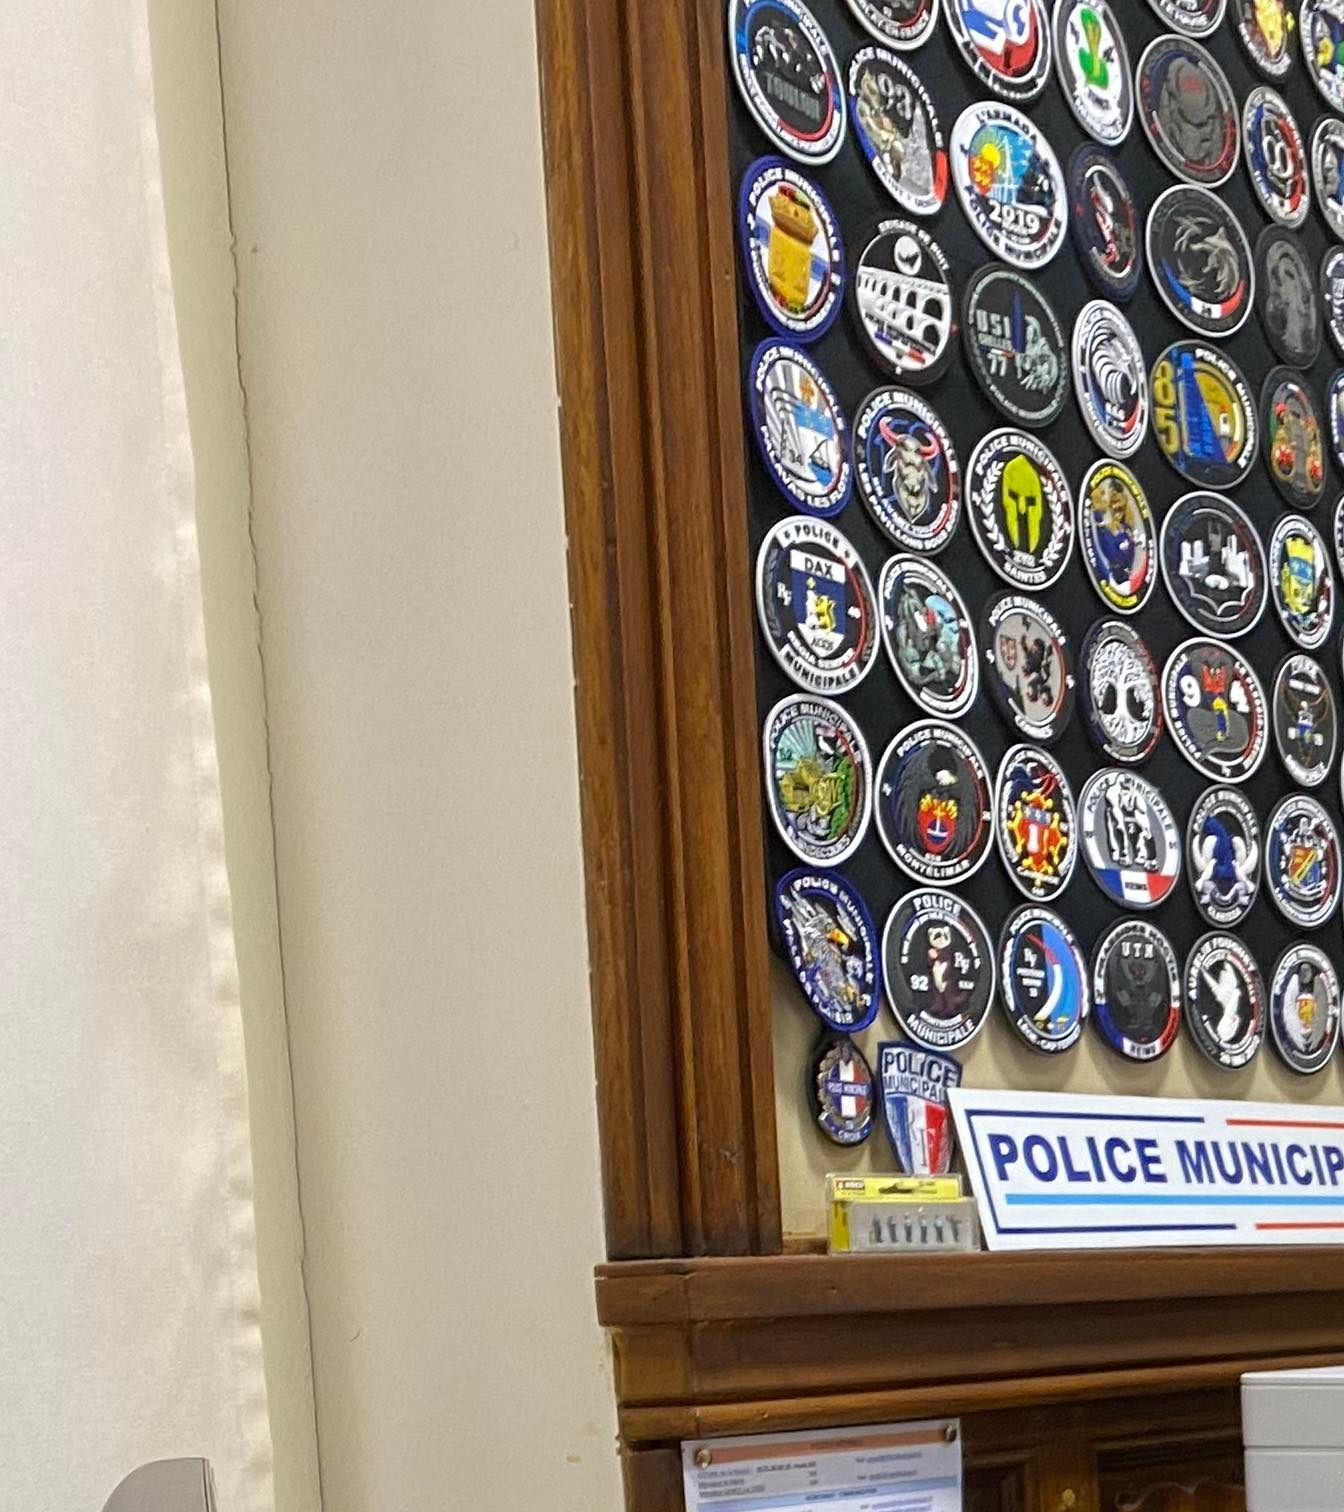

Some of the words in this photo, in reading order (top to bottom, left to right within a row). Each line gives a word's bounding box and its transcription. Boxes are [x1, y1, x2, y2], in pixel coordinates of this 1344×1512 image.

[988, 199, 1040, 235] 2019
[1194, 347, 1238, 380] POLICE
[794, 524, 839, 550] POLICE
[804, 557, 834, 578] DAX
[913, 895, 962, 916] POLICE
[884, 1051, 959, 1088] POLICE
[987, 1134, 1168, 1184] POLICE
